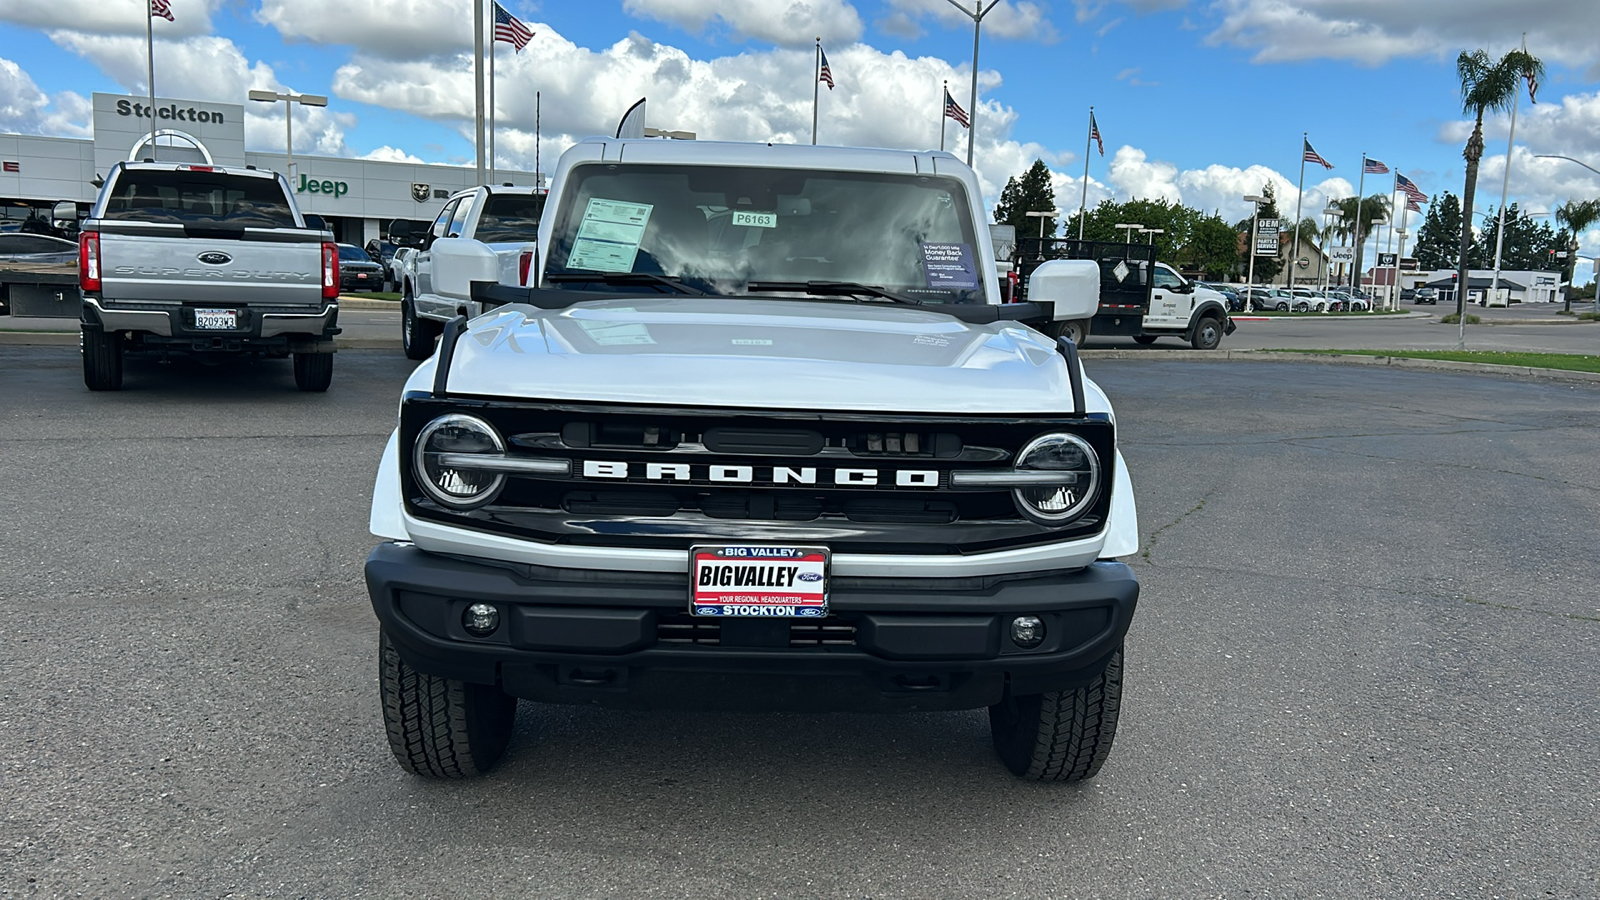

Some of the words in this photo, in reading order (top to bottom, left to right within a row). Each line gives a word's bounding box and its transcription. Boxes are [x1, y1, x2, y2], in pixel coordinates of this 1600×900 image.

[116, 99, 224, 124] Stockton
[297, 173, 348, 199] Jeep
[737, 214, 770, 225] P6163
[1259, 220, 1279, 228] OEM
[1333, 251, 1353, 260] Jeep
[115, 266, 224, 278] SUPER
[233, 269, 310, 280] DUTY
[197, 316, 235, 327] 82093W3
[583, 460, 939, 486] BRONCO
[725, 548, 747, 556] BIG
[751, 548, 796, 557] VALLEY
[800, 572, 820, 582] Ford
[719, 595, 734, 603] YOUR
[761, 596, 802, 604] HEADQUARTERS
[722, 605, 796, 616] STOCKTON
